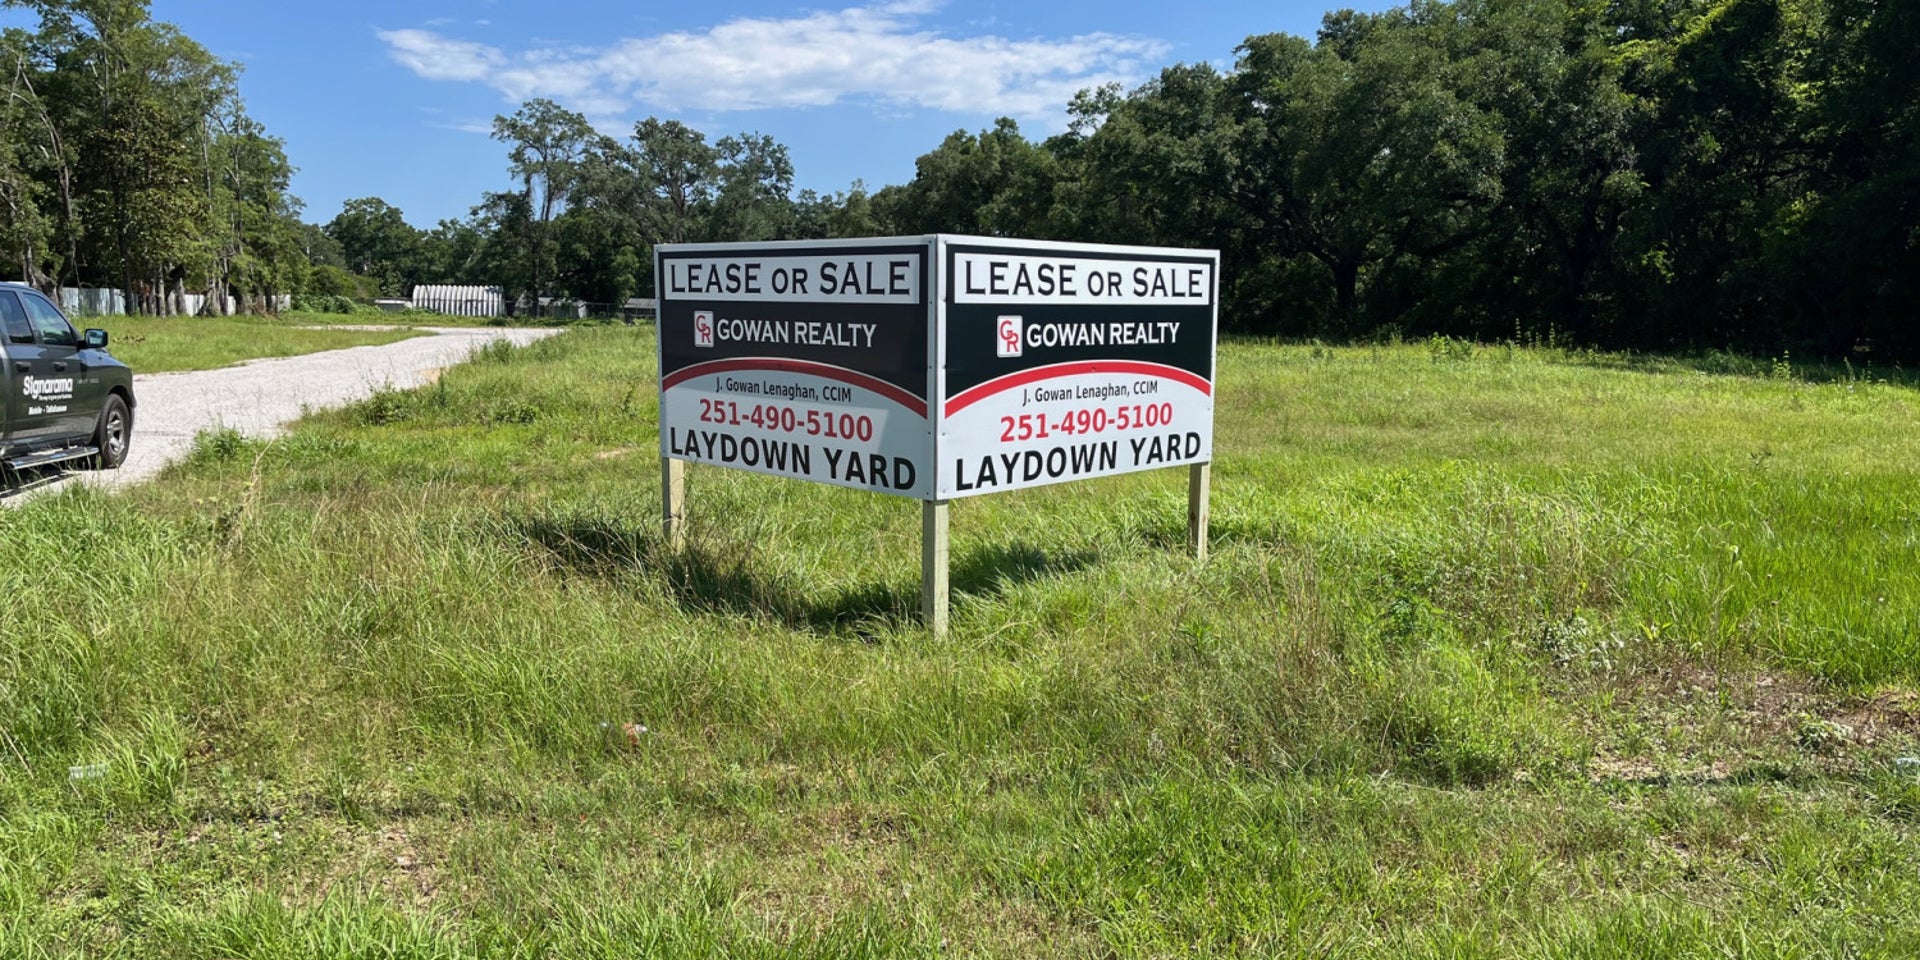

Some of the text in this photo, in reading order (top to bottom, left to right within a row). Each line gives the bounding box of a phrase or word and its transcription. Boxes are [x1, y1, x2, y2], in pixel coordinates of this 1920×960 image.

[670, 260, 910, 296] LEASE OR SALE
[965, 260, 1203, 298] LEASE OR SALE
[717, 318, 877, 347] GOWAN REALTY
[1026, 322, 1180, 348] GOWAN REALTY
[23, 375, 73, 399] Signarama
[716, 377, 852, 403] J. Gowan Lenaghan, CCIM
[1022, 380, 1158, 407] J. Gowan Lenaghan, CCIM
[699, 398, 873, 442] 251-490-5100
[1000, 402, 1173, 442] 251-490-5100
[670, 427, 916, 490] LAYDOWN YARD
[956, 431, 1201, 491] LAYDOWN YARD
